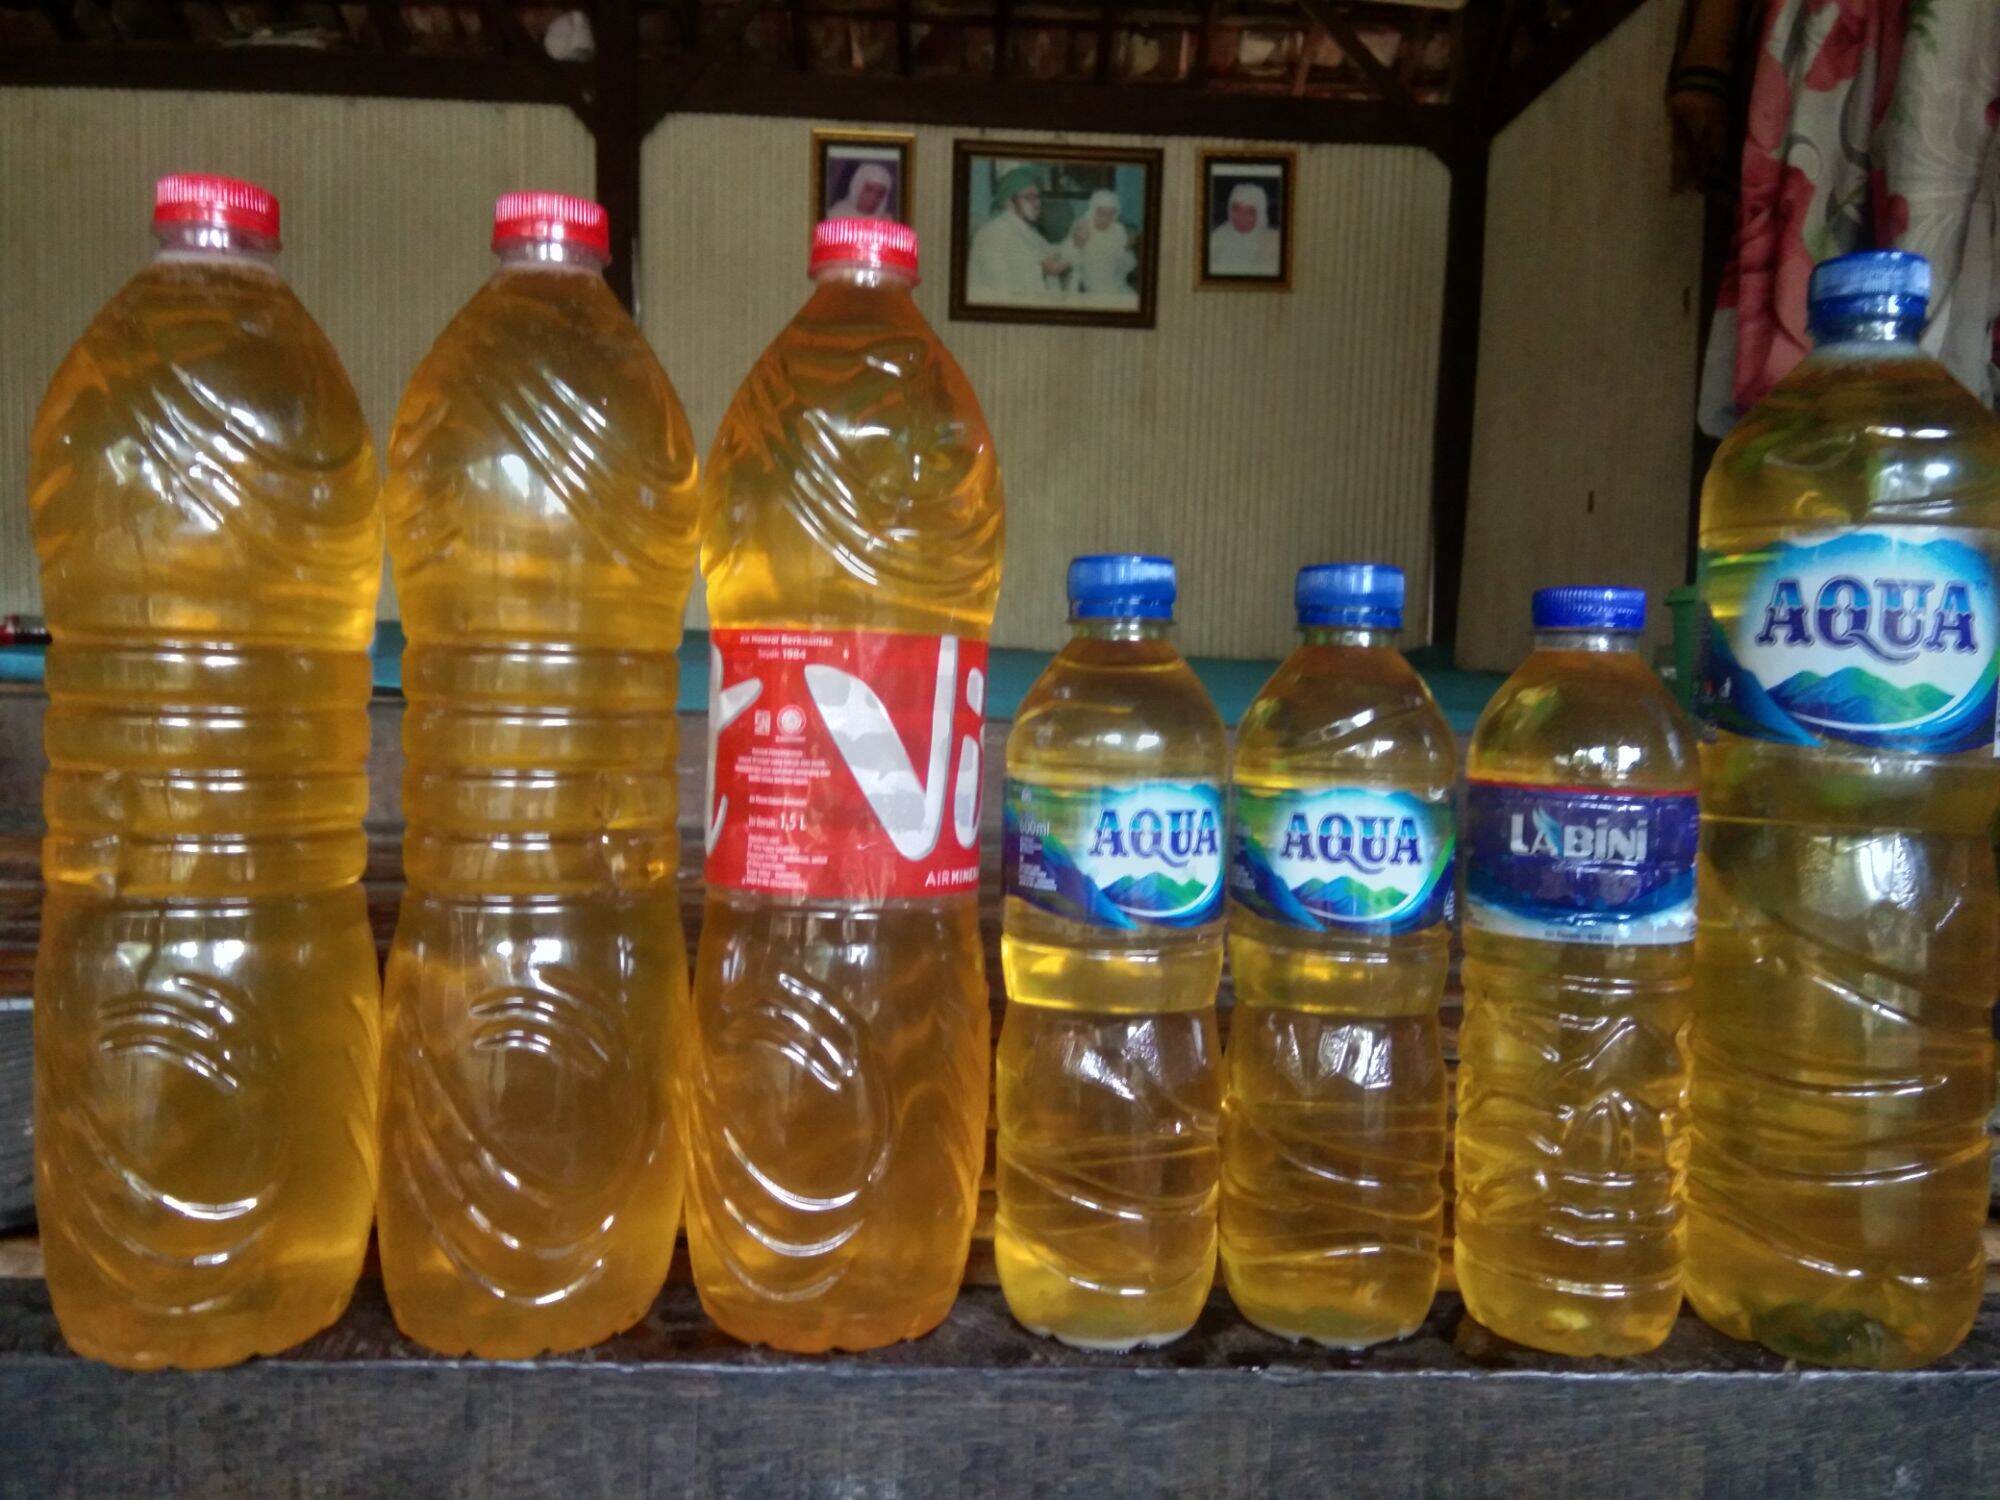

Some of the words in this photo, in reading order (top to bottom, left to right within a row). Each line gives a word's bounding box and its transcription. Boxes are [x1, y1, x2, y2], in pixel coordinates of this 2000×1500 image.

[1754, 574, 1979, 666] AQUA
[1087, 807, 1219, 868] AQUA
[1280, 811, 1422, 875] AQUA
[925, 870, 950, 888] AIR
